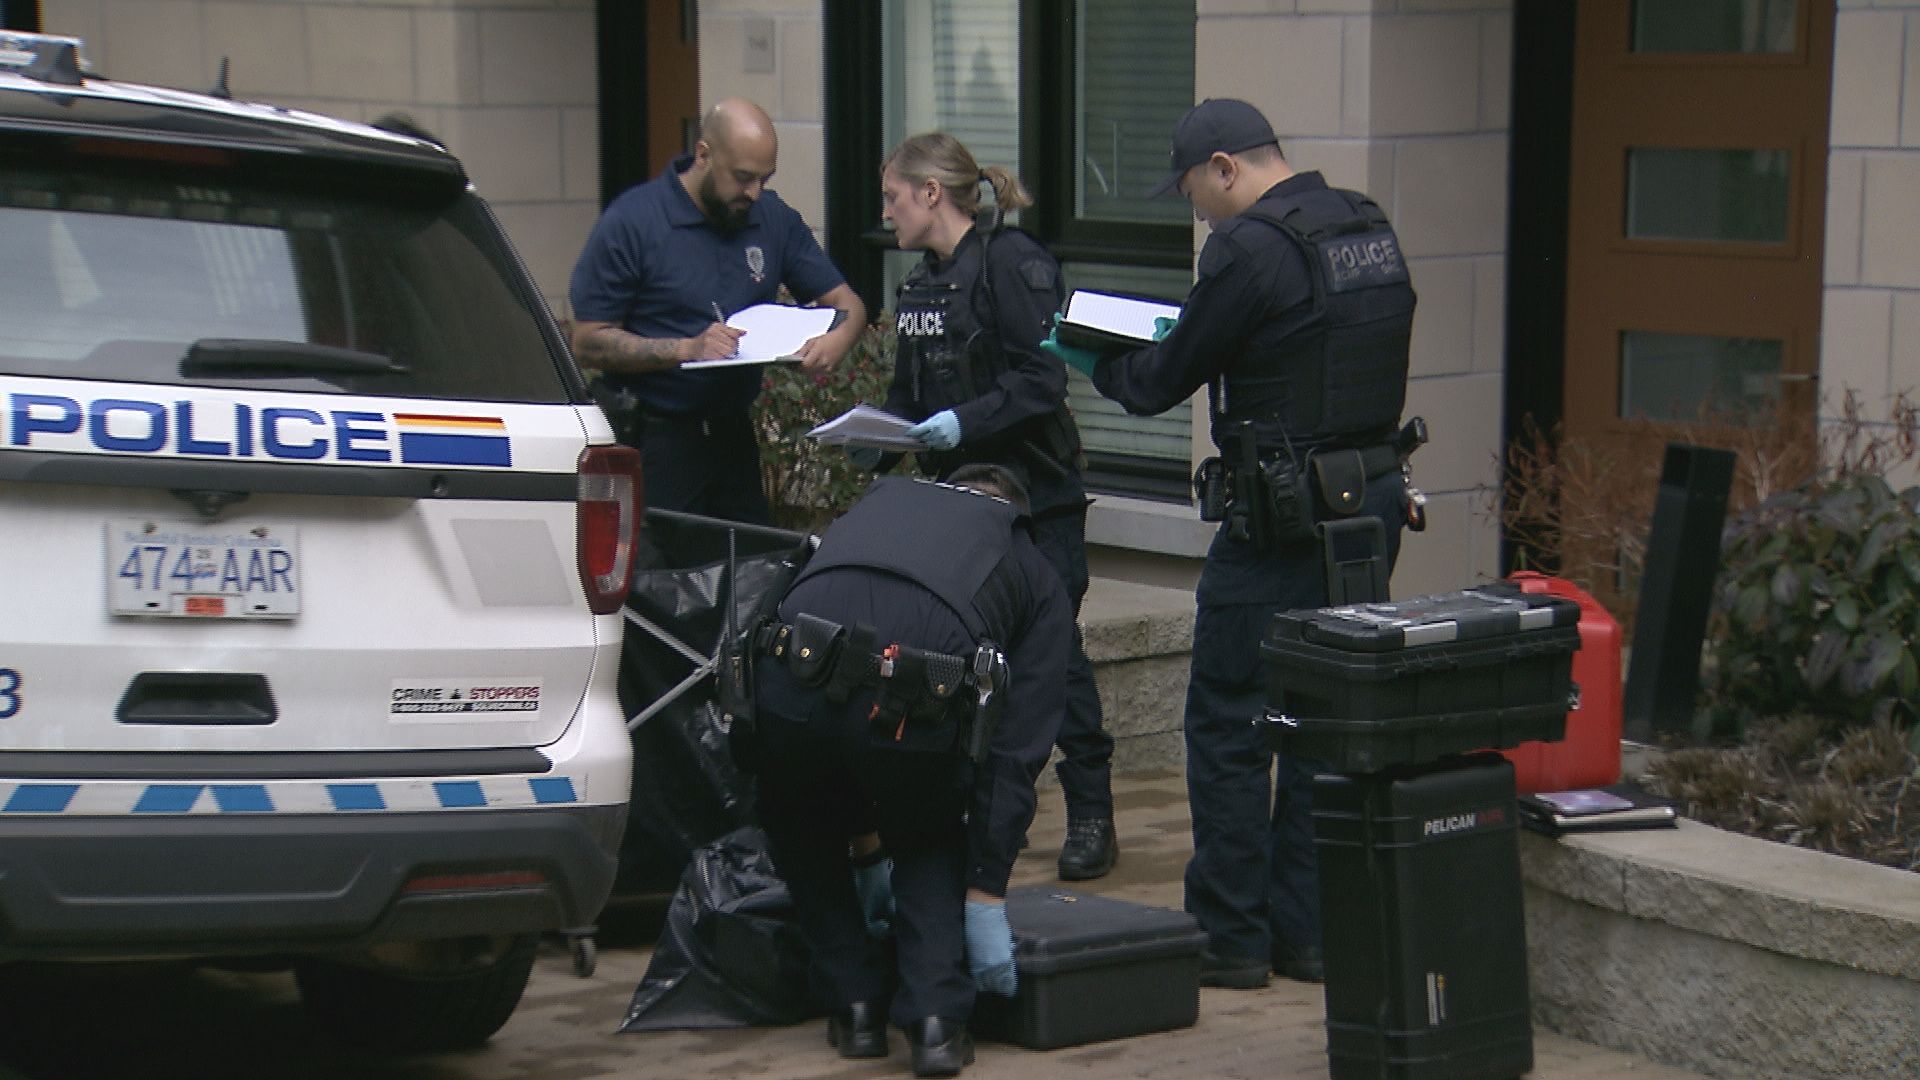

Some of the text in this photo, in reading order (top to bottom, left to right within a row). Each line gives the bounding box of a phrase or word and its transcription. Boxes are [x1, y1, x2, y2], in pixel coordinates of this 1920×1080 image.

[1327, 240, 1396, 271] POLICE
[897, 311, 945, 336] POLICE
[9, 393, 393, 463] POLICE
[118, 547, 295, 592] 474 AAR
[391, 686, 540, 701] CRIME STOPPERS
[1423, 813, 1477, 836] PELICAN
